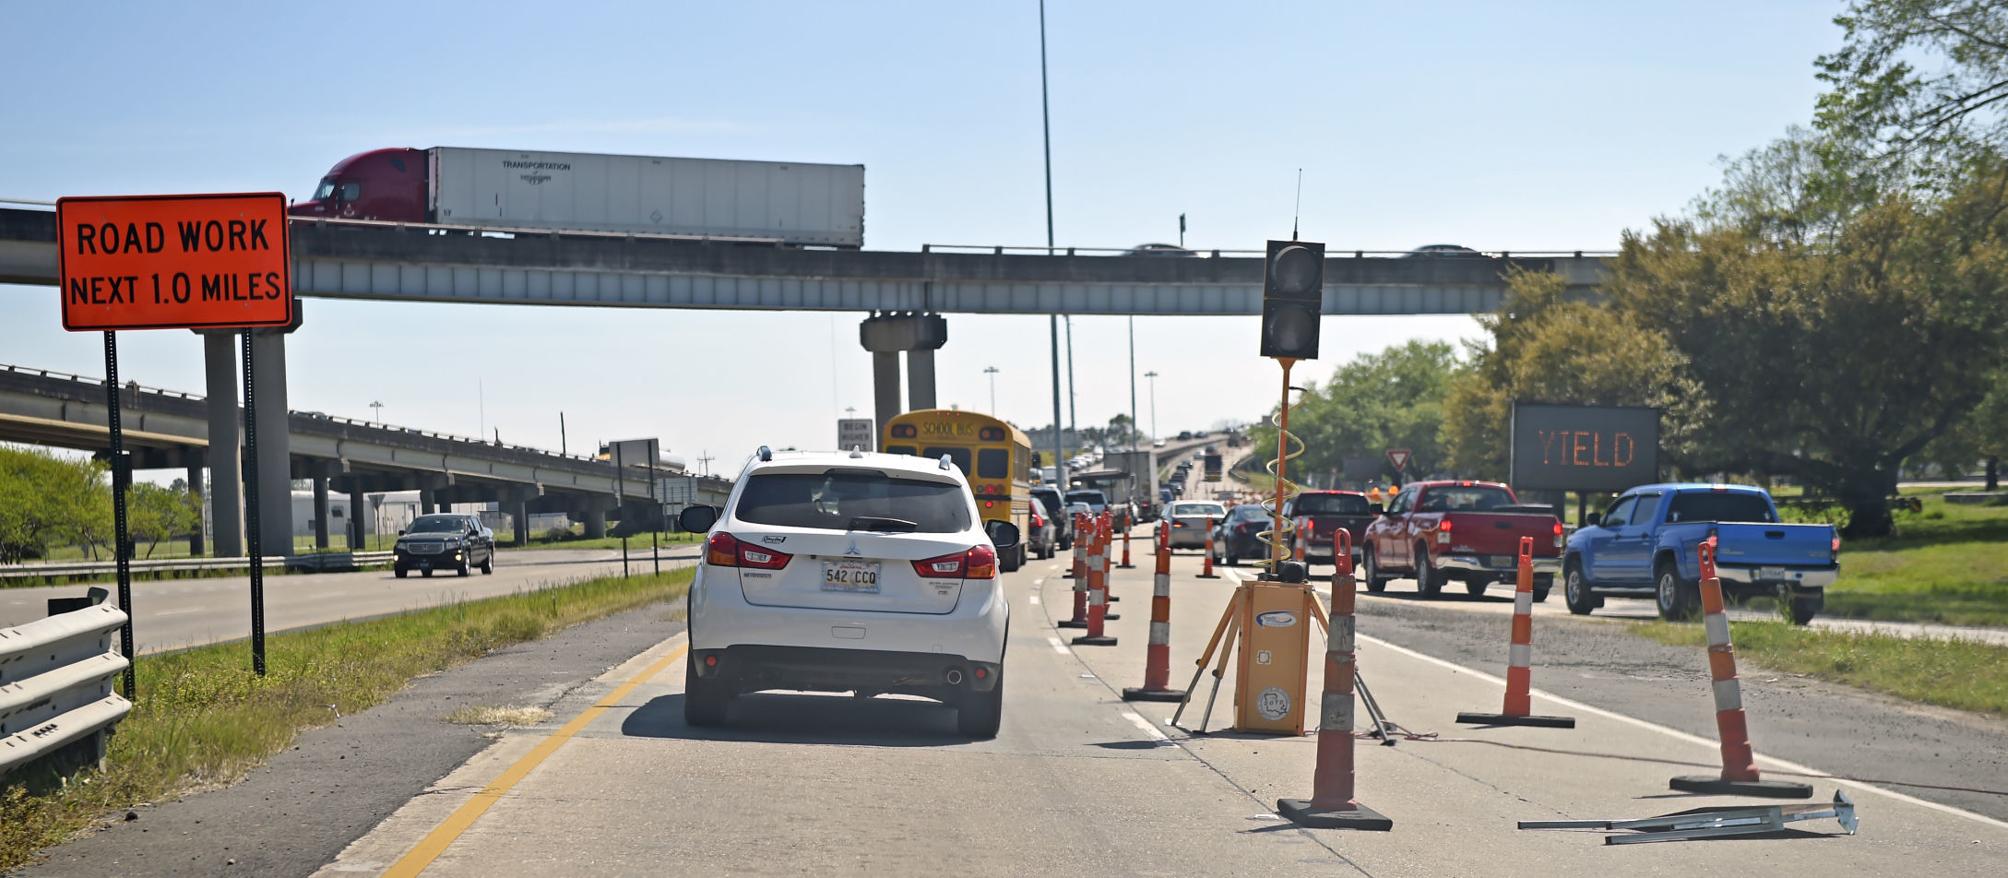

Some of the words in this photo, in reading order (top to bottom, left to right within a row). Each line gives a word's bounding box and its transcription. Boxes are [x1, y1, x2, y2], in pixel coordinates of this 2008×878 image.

[503, 160, 571, 171] TRANSPORTATION
[77, 222, 165, 255] ROAD
[178, 219, 269, 252] WORK
[70, 276, 139, 305] NEXT
[152, 272, 191, 304] 1.0
[201, 272, 281, 302] MILES
[923, 422, 952, 434] SCHOOL
[956, 423, 975, 435] BUS
[1538, 430, 1633, 467] YIELD
[826, 569, 848, 582] 542
